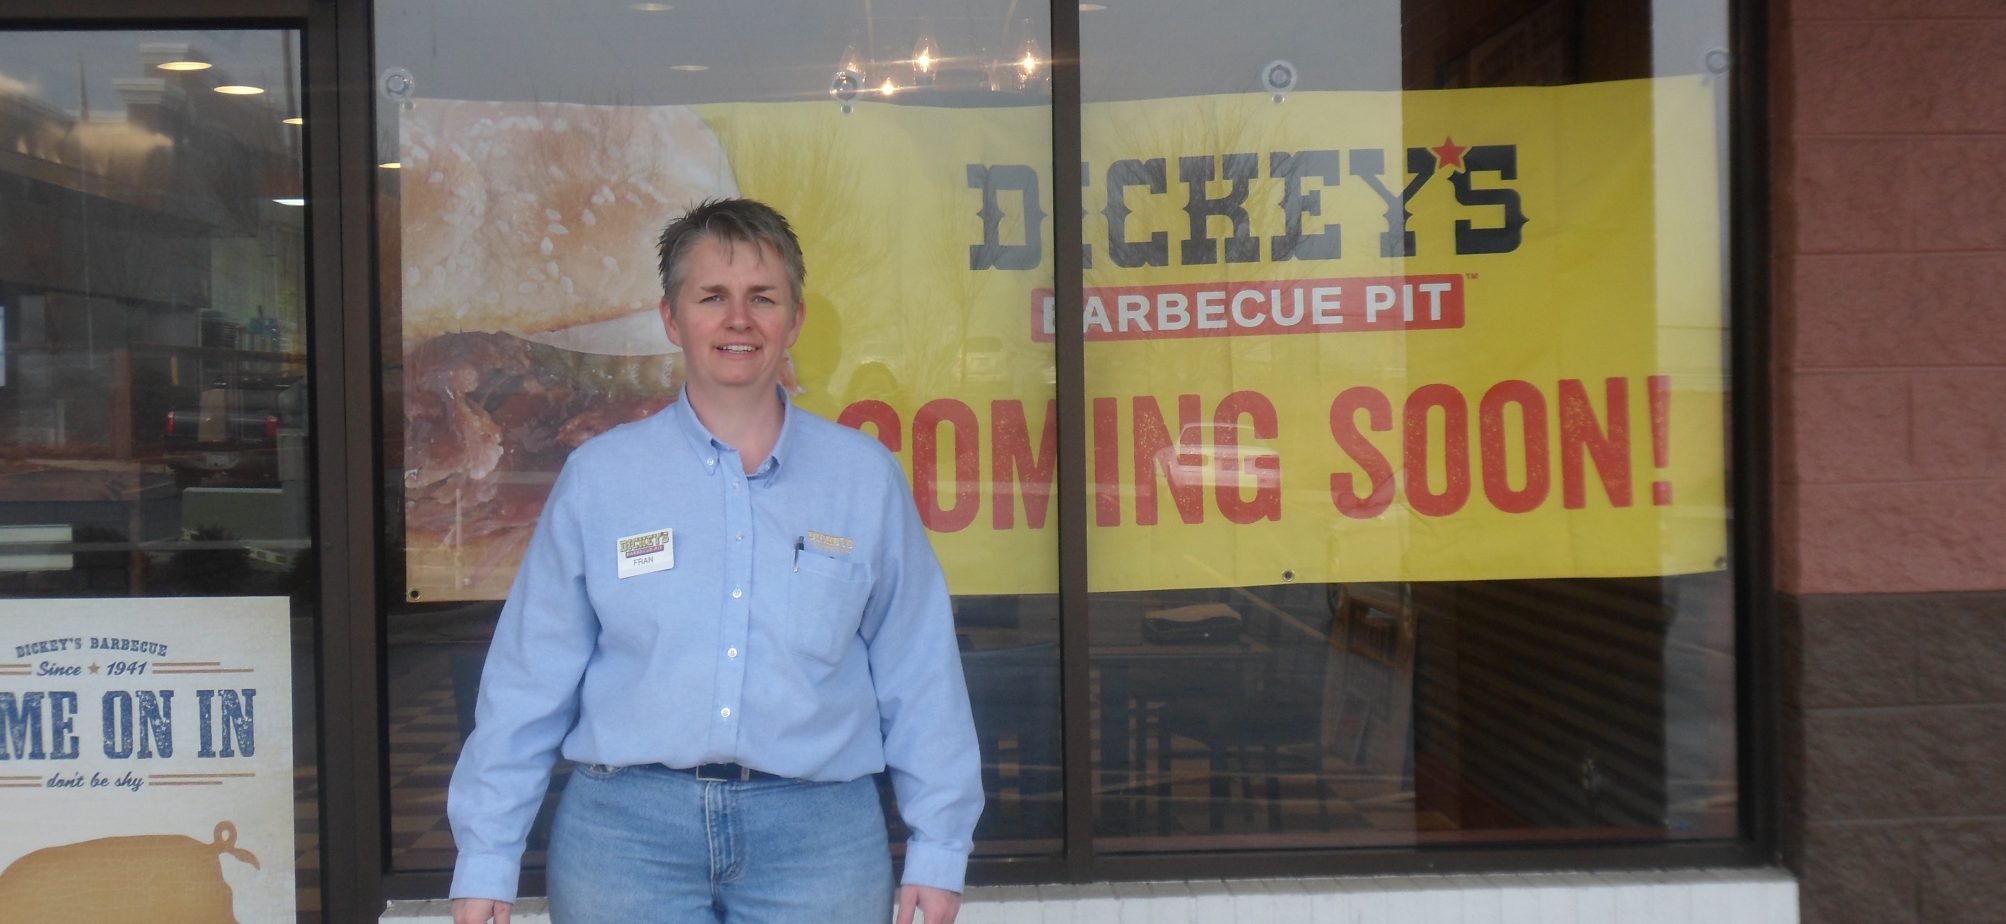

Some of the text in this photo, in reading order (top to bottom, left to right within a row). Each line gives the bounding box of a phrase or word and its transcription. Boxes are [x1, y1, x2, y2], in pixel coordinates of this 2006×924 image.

[1366, 283, 1452, 333] PIT
[1329, 375, 1673, 517] SOON!
[633, 556, 654, 566] FRAN
[16, 637, 168, 658] DICKEY'S BARBECUE
[36, 661, 148, 676] Since 1941
[101, 690, 174, 759] ON
[196, 688, 257, 758] IN
[46, 771, 144, 792] don't be shy
